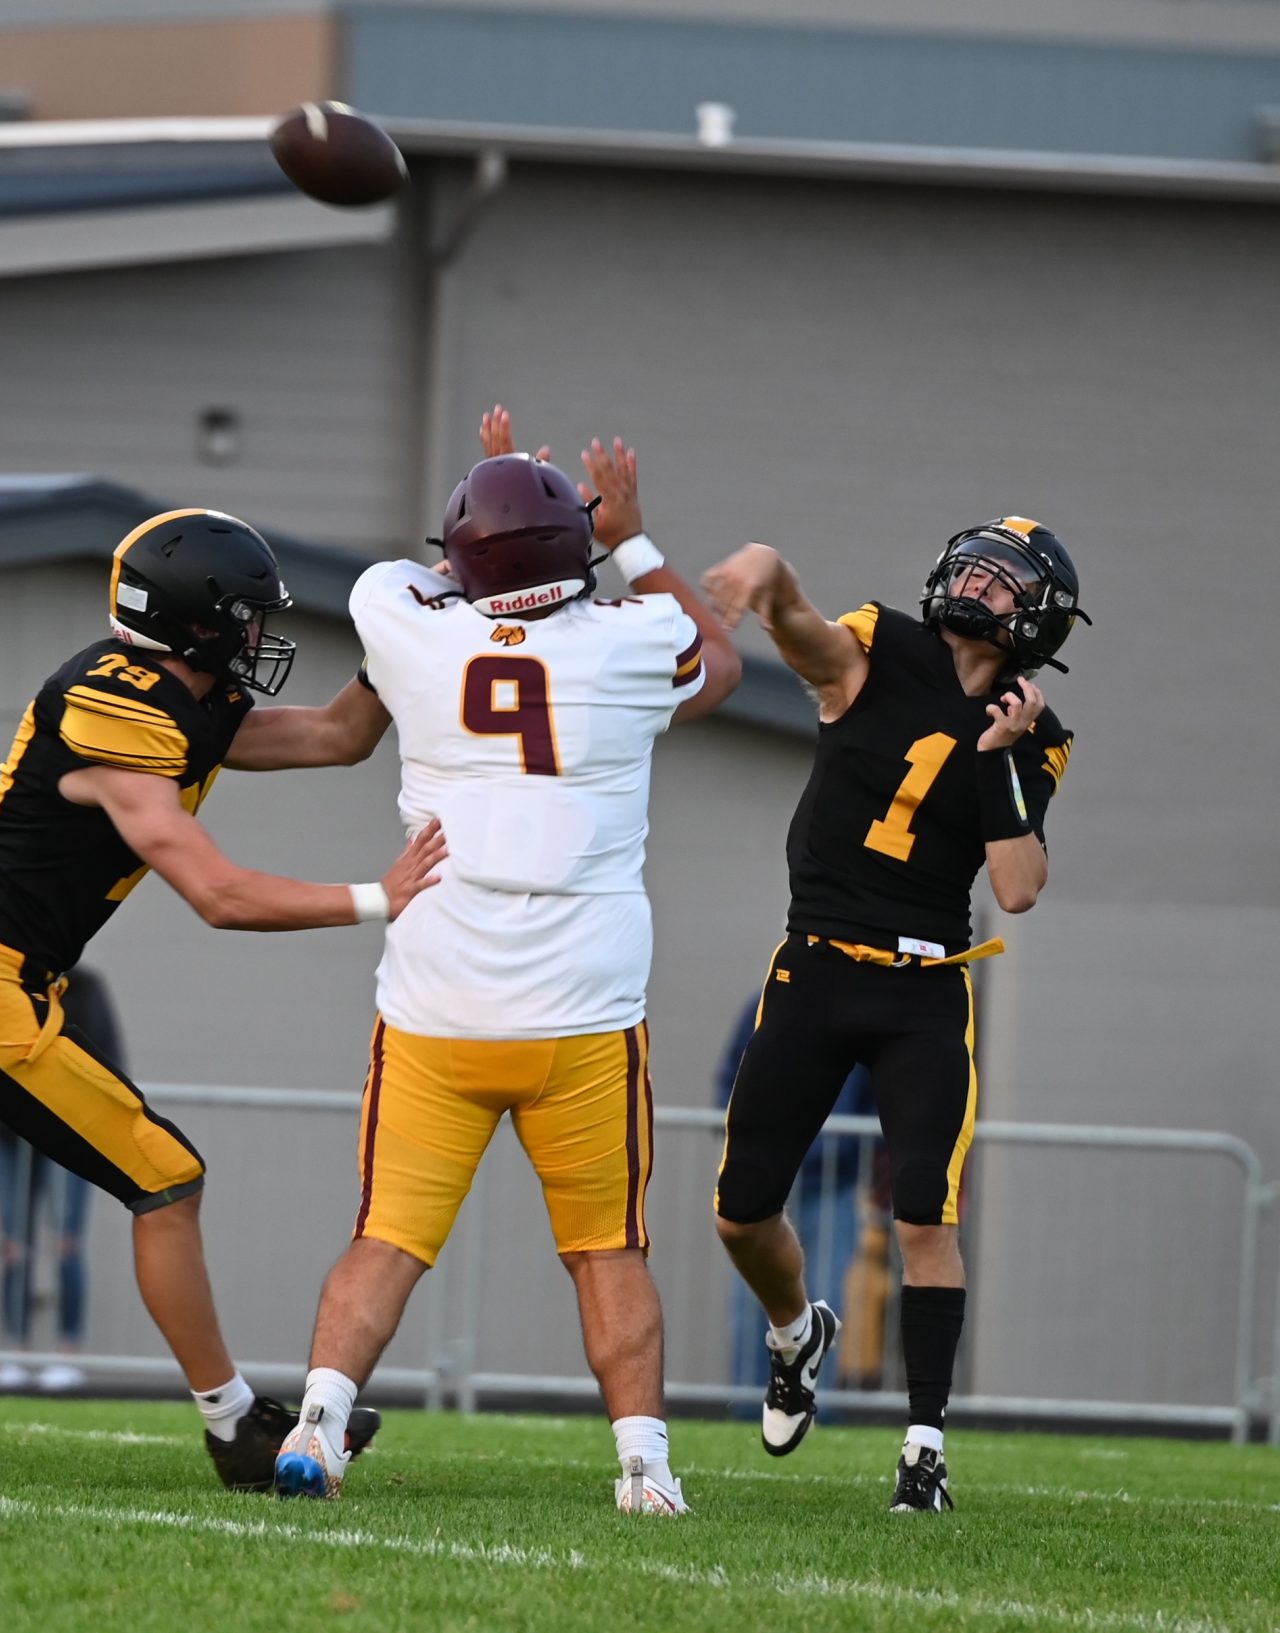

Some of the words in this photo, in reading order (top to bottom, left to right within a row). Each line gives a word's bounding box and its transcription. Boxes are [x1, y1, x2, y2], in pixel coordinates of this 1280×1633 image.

[489, 586, 562, 613] Riddell
[459, 652, 563, 776] 9
[864, 731, 957, 862] 1
